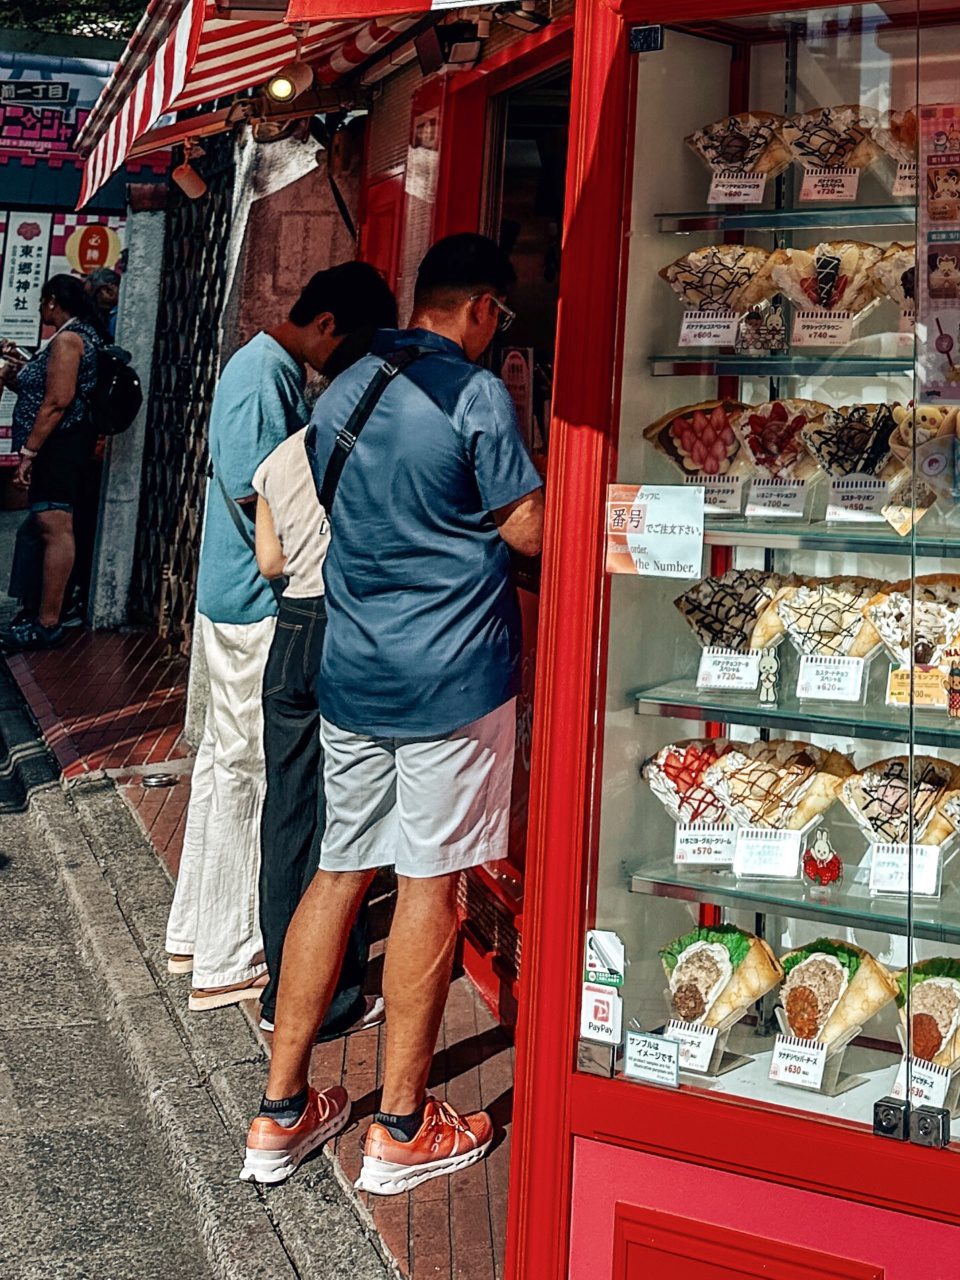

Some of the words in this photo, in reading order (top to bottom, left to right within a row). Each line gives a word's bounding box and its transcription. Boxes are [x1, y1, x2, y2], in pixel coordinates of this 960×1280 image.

[14, 244, 34, 311] 東郷神社
[613, 508, 642, 528] 番号
[646, 523, 701, 536] でご注文下さい。
[635, 557, 650, 570] the
[653, 560, 694, 573] Number.
[692, 847, 713, 855] ¥570
[588, 1021, 614, 1036] PayPay
[629, 1037, 659, 1050] サンプルは
[637, 1049, 676, 1064] イメージです。
[784, 1064, 802, 1075] ¥630
